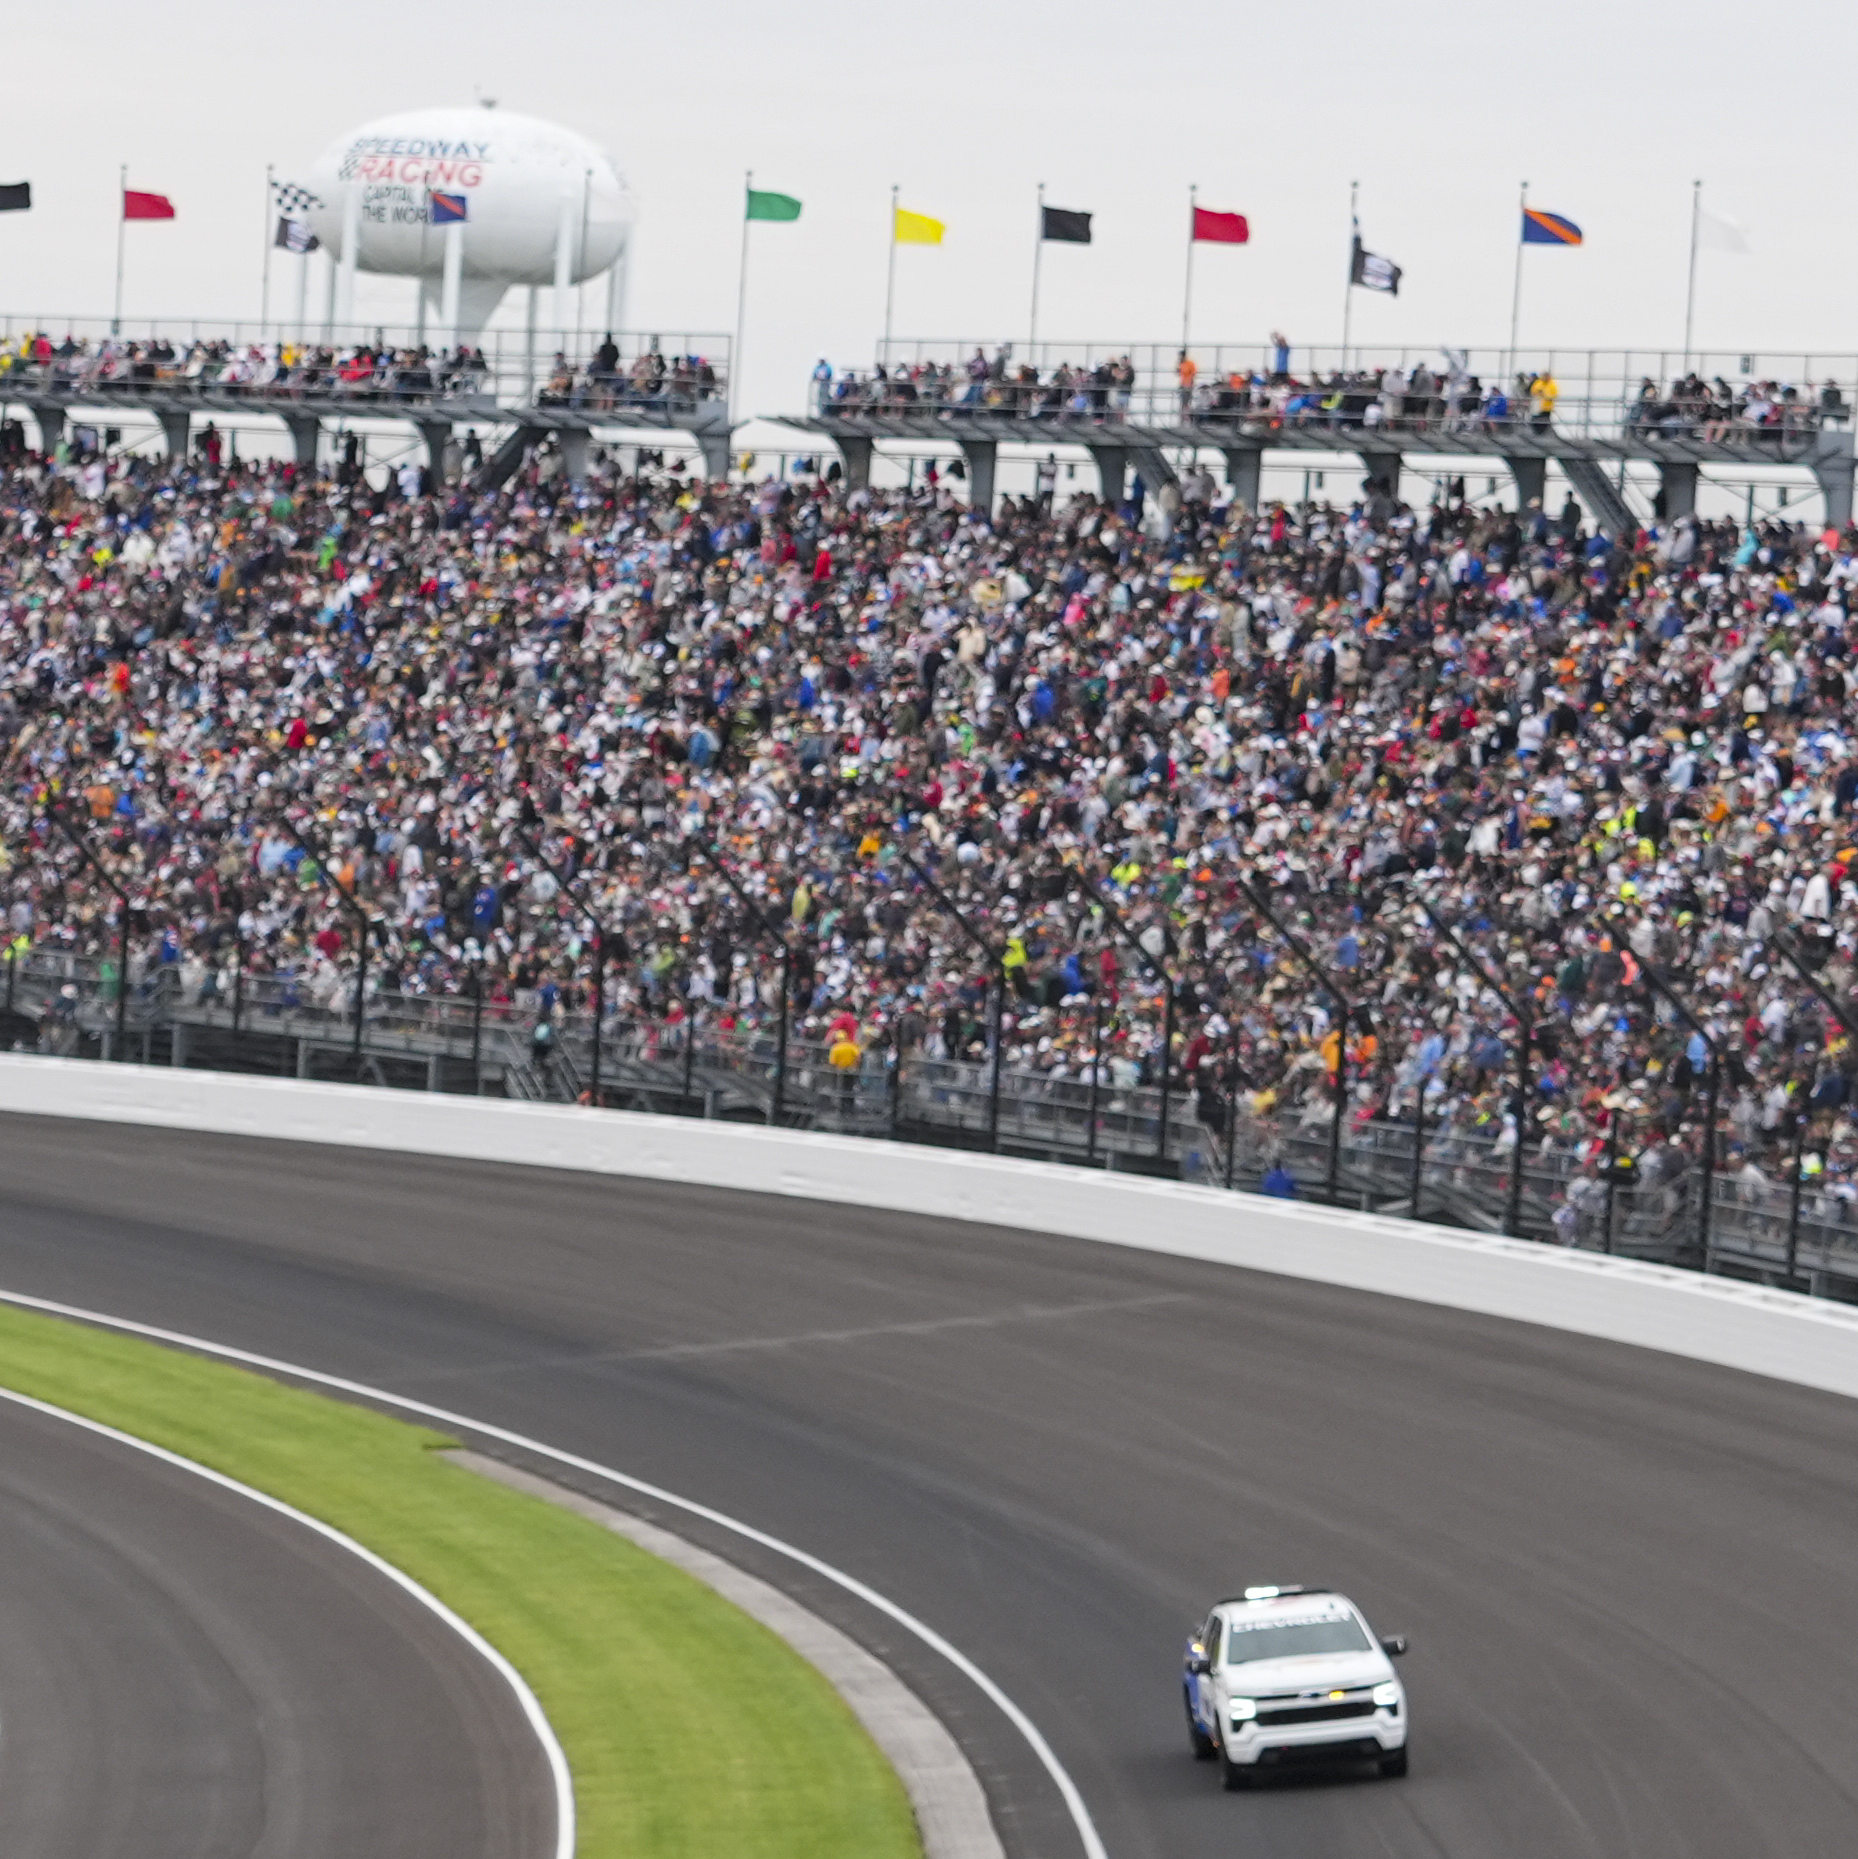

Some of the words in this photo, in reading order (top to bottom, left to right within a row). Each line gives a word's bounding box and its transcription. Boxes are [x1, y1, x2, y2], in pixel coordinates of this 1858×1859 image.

[350, 137, 491, 159] SPEEDWAY
[355, 158, 483, 188] RACING
[362, 204, 386, 223] THE
[392, 206, 429, 225] WOR
[1232, 1613, 1350, 1634] CHEVROLET
